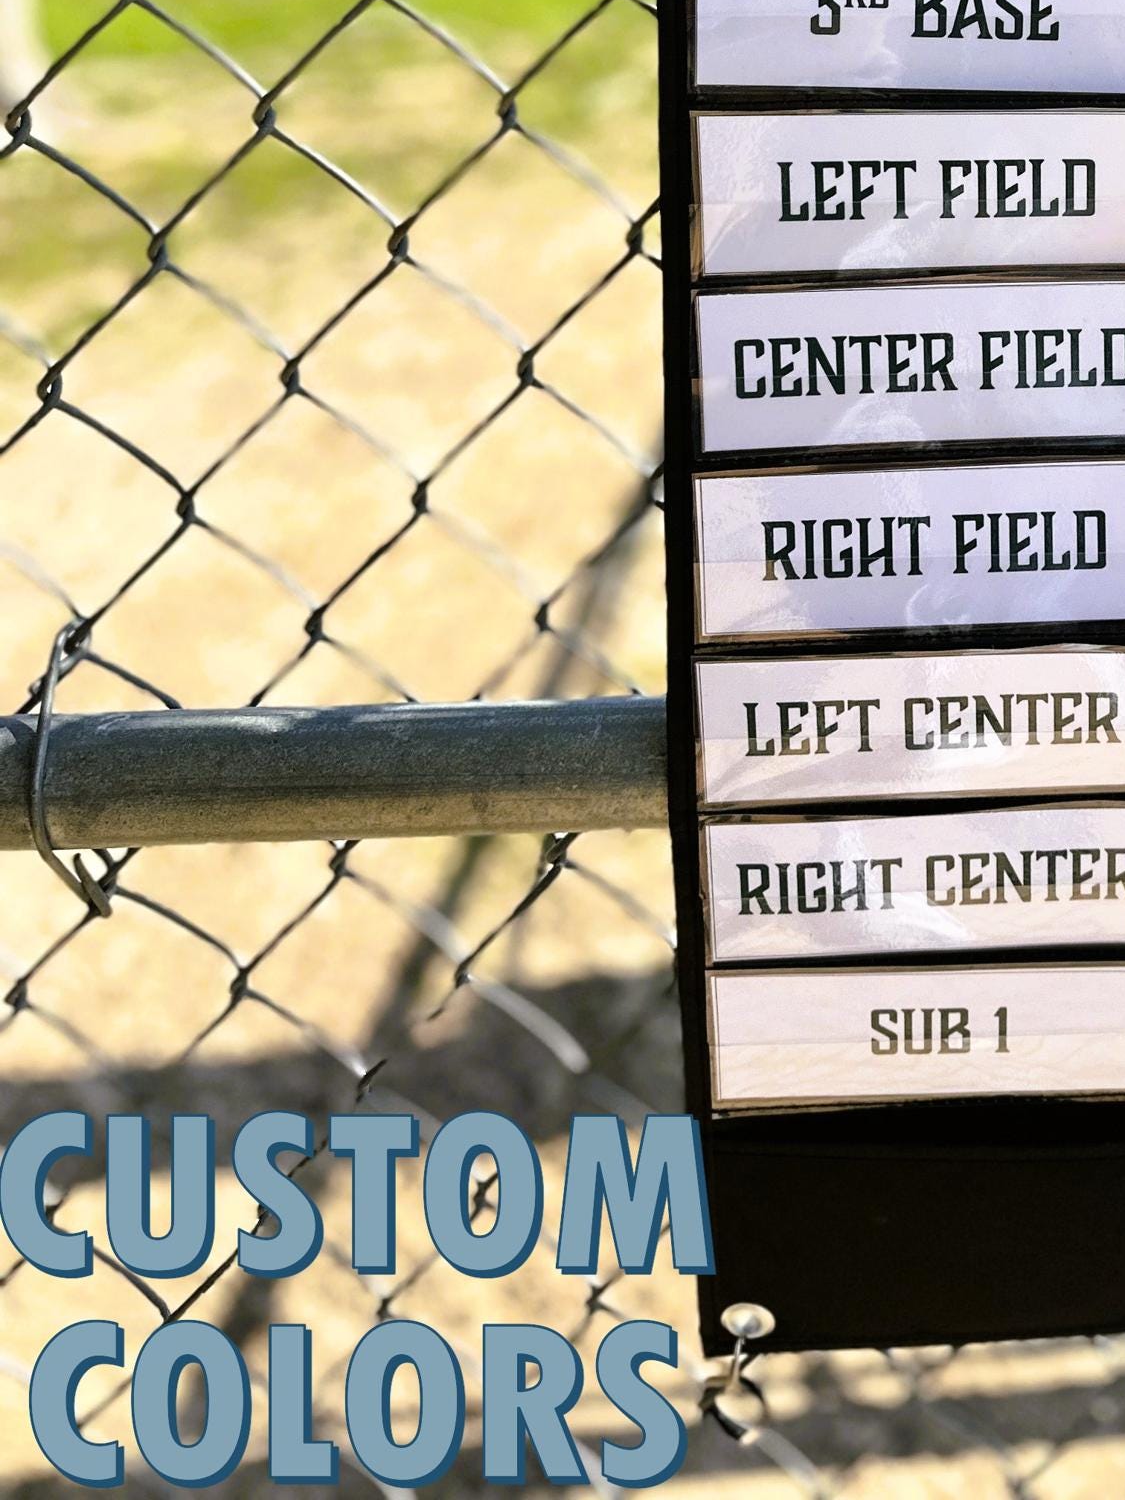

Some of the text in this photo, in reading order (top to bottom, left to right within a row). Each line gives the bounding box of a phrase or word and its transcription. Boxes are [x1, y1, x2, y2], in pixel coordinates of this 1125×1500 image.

[777, 158, 1095, 222] LEFT FIELD
[734, 332, 958, 399] CENTER
[762, 509, 1107, 582] RIGHT FIELD
[743, 692, 1121, 757] LEFT CENTER
[737, 857, 902, 915] RIGHT
[870, 1007, 1010, 1056] SUB 1
